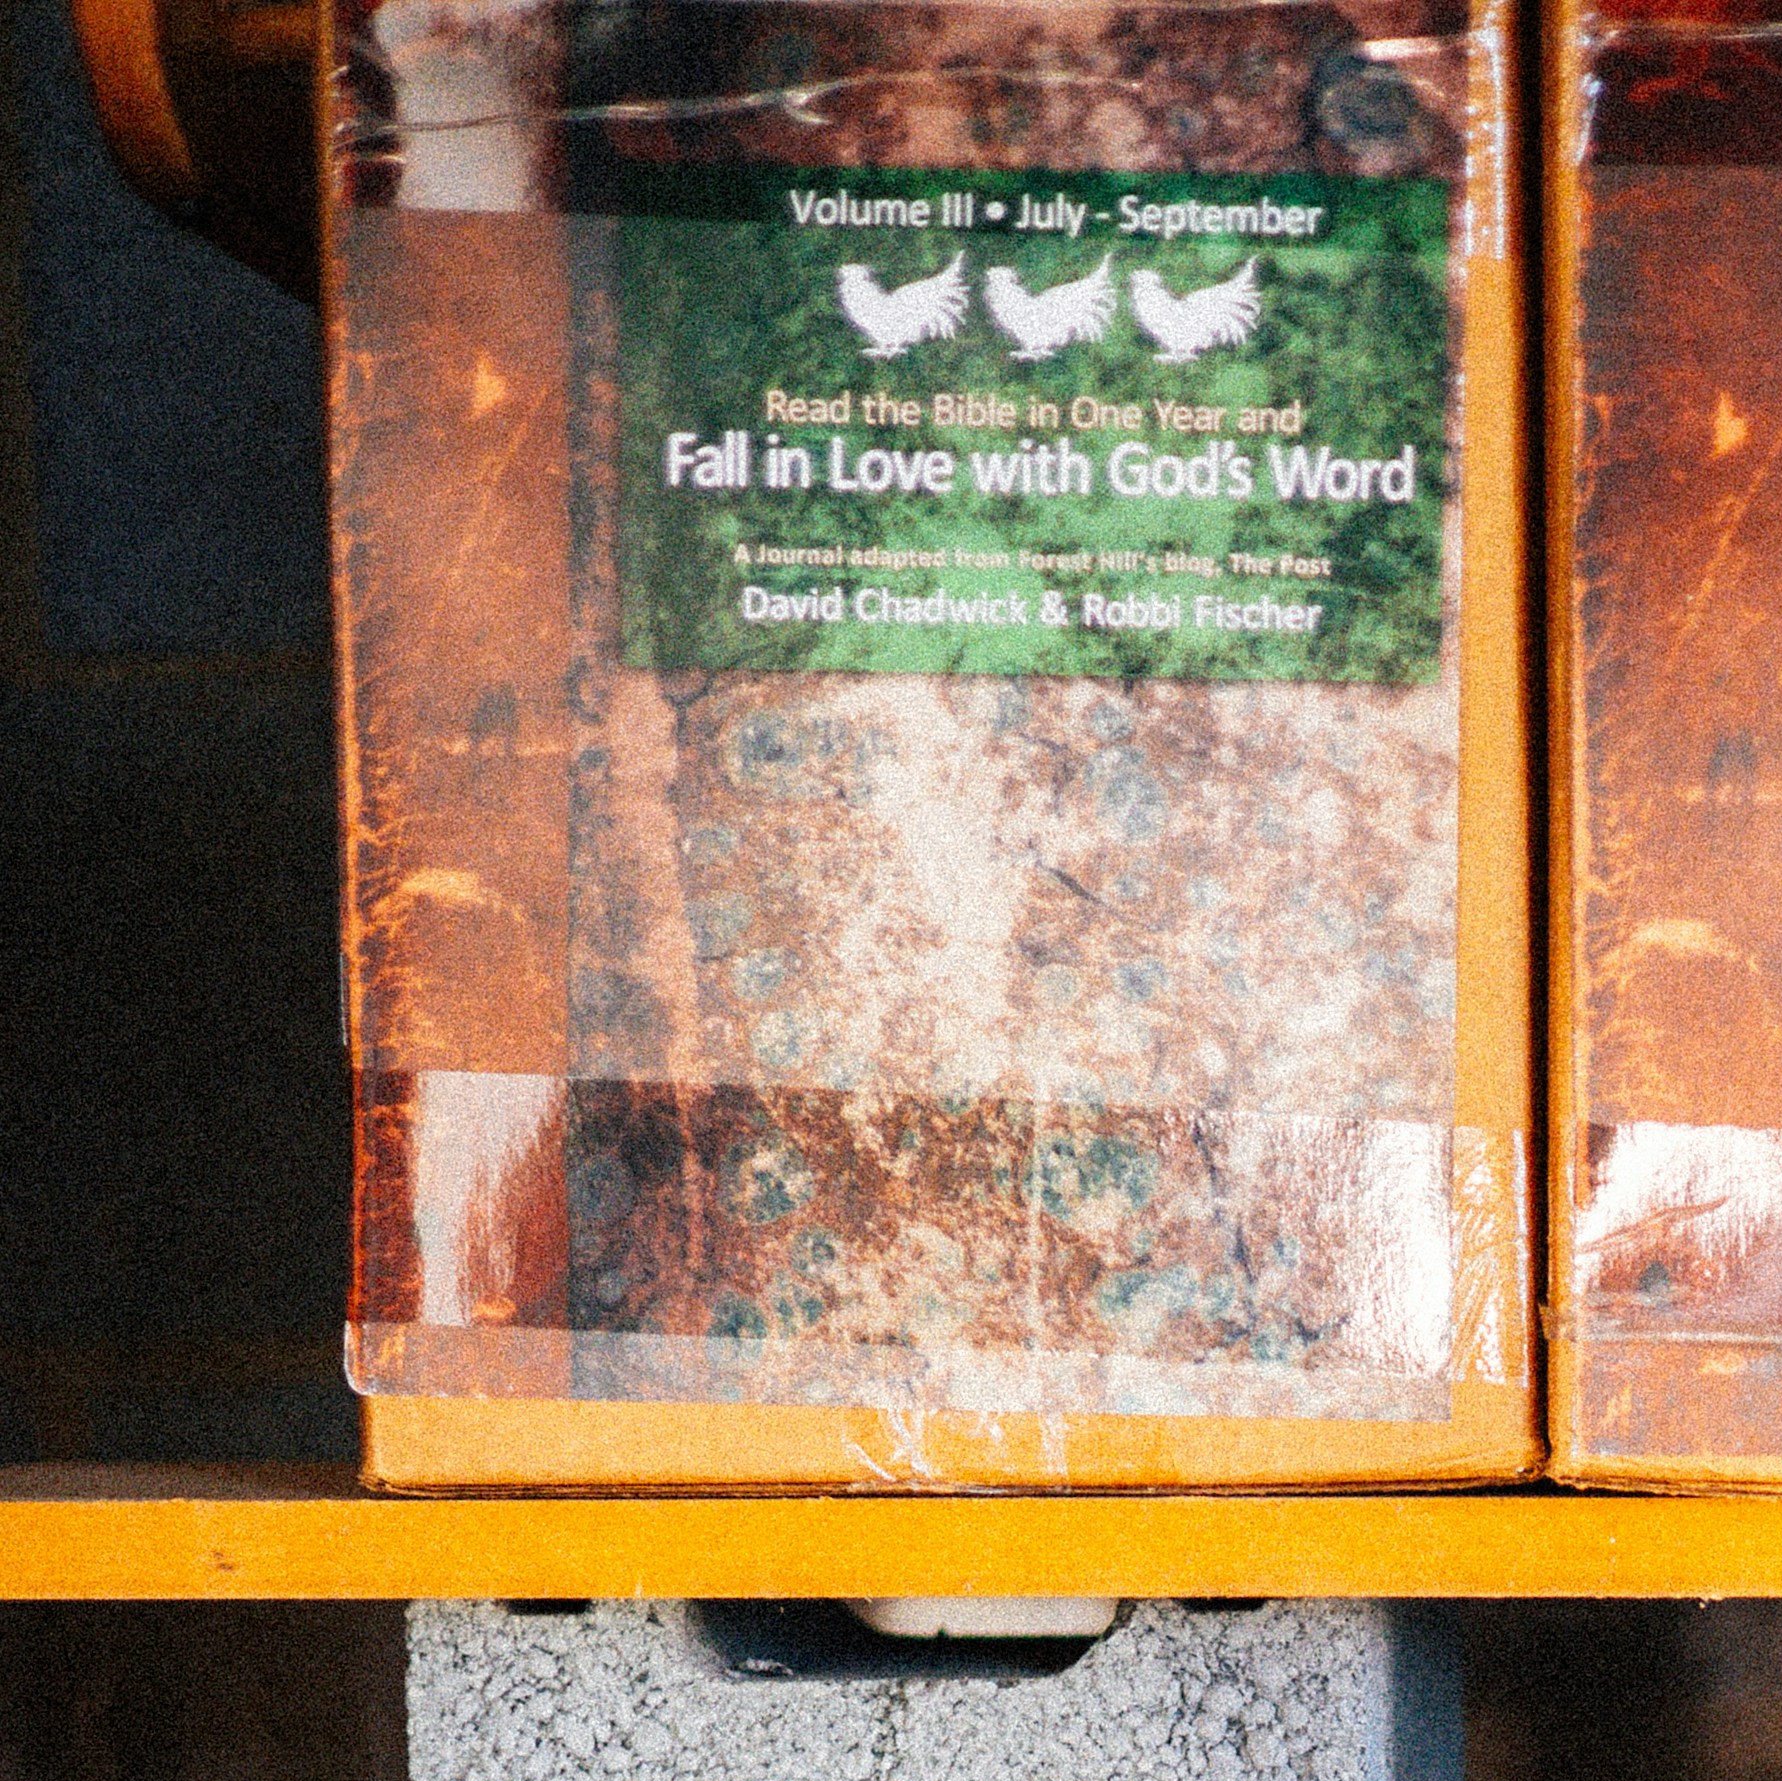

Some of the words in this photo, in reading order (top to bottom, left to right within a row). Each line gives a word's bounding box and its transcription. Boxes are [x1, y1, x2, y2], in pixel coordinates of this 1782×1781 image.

[789, 189, 930, 227] Volume
[942, 192, 973, 228] III
[1016, 195, 1087, 239] July
[1118, 195, 1323, 239] September
[766, 390, 850, 425] Read
[863, 394, 921, 427] the
[933, 393, 1017, 429] Bible
[1029, 396, 1058, 429] in
[1070, 396, 1143, 431] One
[1153, 399, 1226, 433] Year
[1238, 401, 1302, 434] and
[665, 429, 749, 489] Fall
[765, 433, 812, 490] in
[828, 436, 955, 493] Love
[971, 436, 1092, 497] with
[1107, 439, 1254, 499] God's
[1266, 444, 1415, 501] Word
[733, 543, 751, 564] A
[757, 543, 844, 566] Journal
[849, 546, 946, 571] adapted
[954, 548, 1010, 569] from
[1018, 549, 1093, 571] Forest
[1229, 552, 1272, 575] The
[1280, 553, 1332, 577] Post
[741, 585, 844, 622] David
[853, 586, 1028, 626] Chadwick
[1040, 589, 1067, 627] &
[1082, 593, 1182, 630] Robbi
[1194, 594, 1322, 632] Fischer
